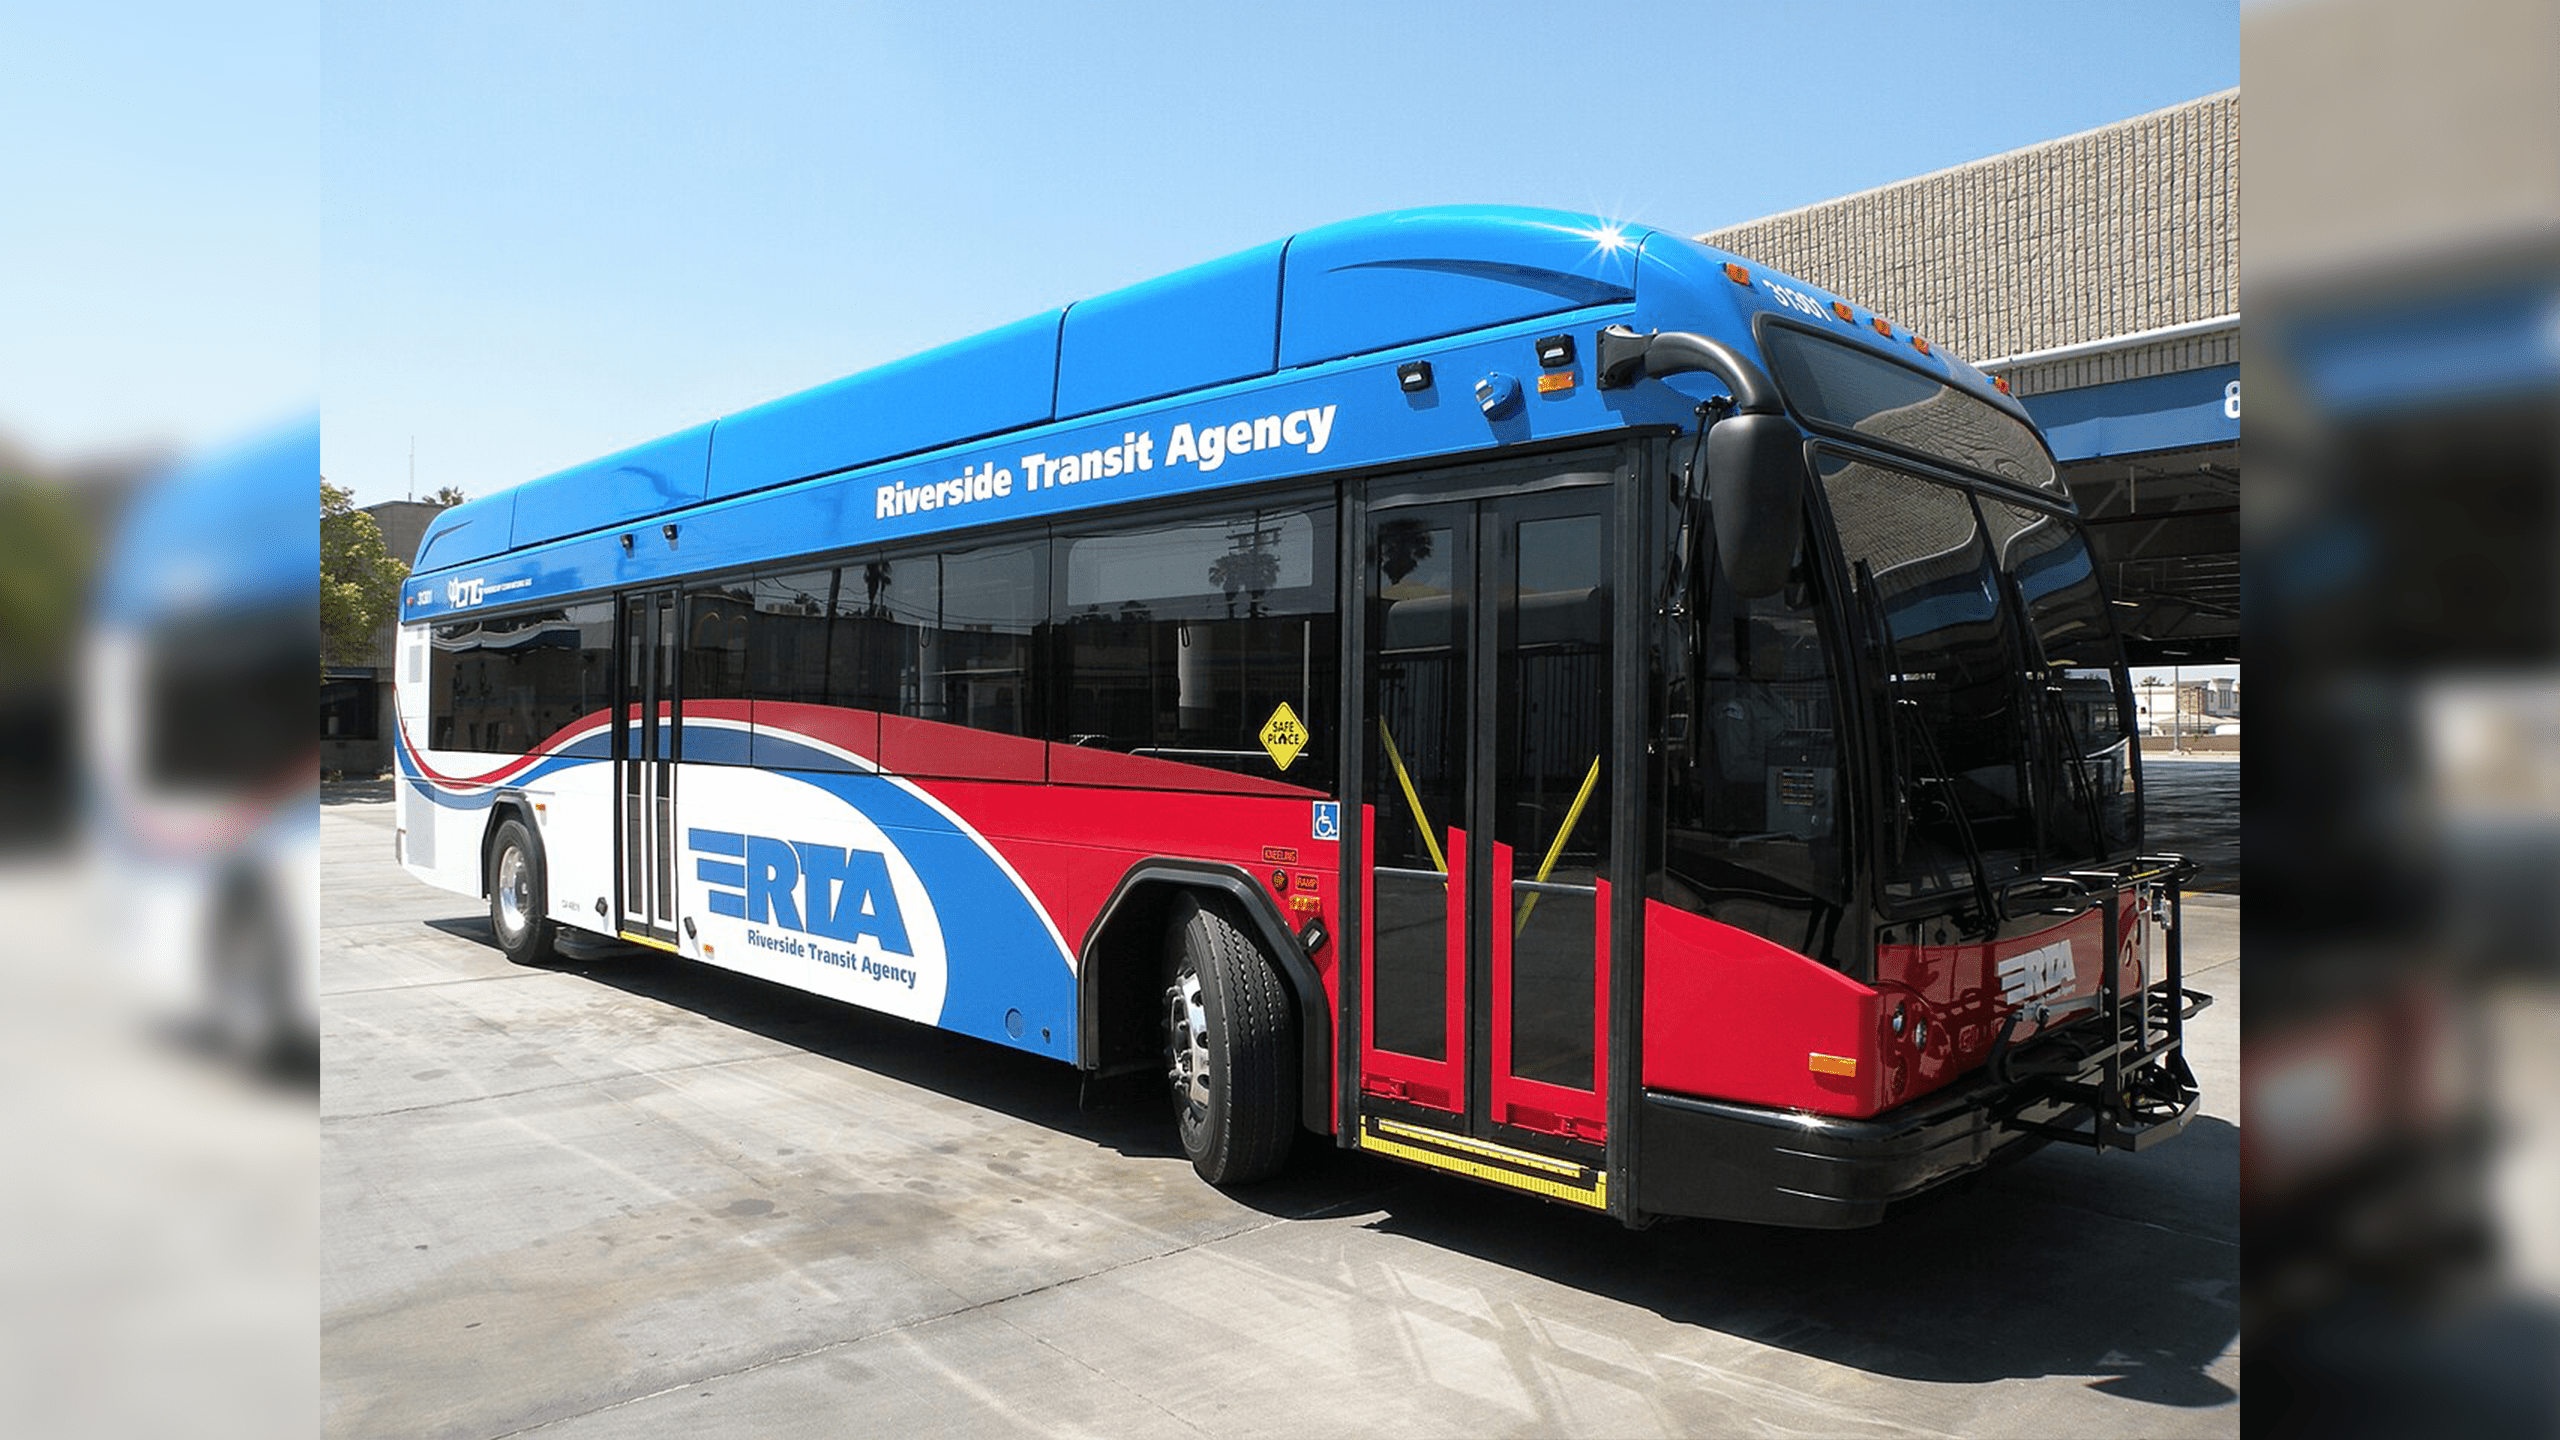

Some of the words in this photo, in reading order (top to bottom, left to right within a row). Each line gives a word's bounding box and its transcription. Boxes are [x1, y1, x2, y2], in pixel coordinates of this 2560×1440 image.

[1762, 279, 1832, 322] 31301
[875, 461, 1012, 520] Riverside
[1021, 431, 1154, 492] Transit
[1164, 404, 1338, 473] Agency
[1272, 721, 1294, 733] SAFE
[748, 929, 805, 957] Riverside
[808, 943, 857, 971] Transit
[861, 956, 917, 989] Agency
